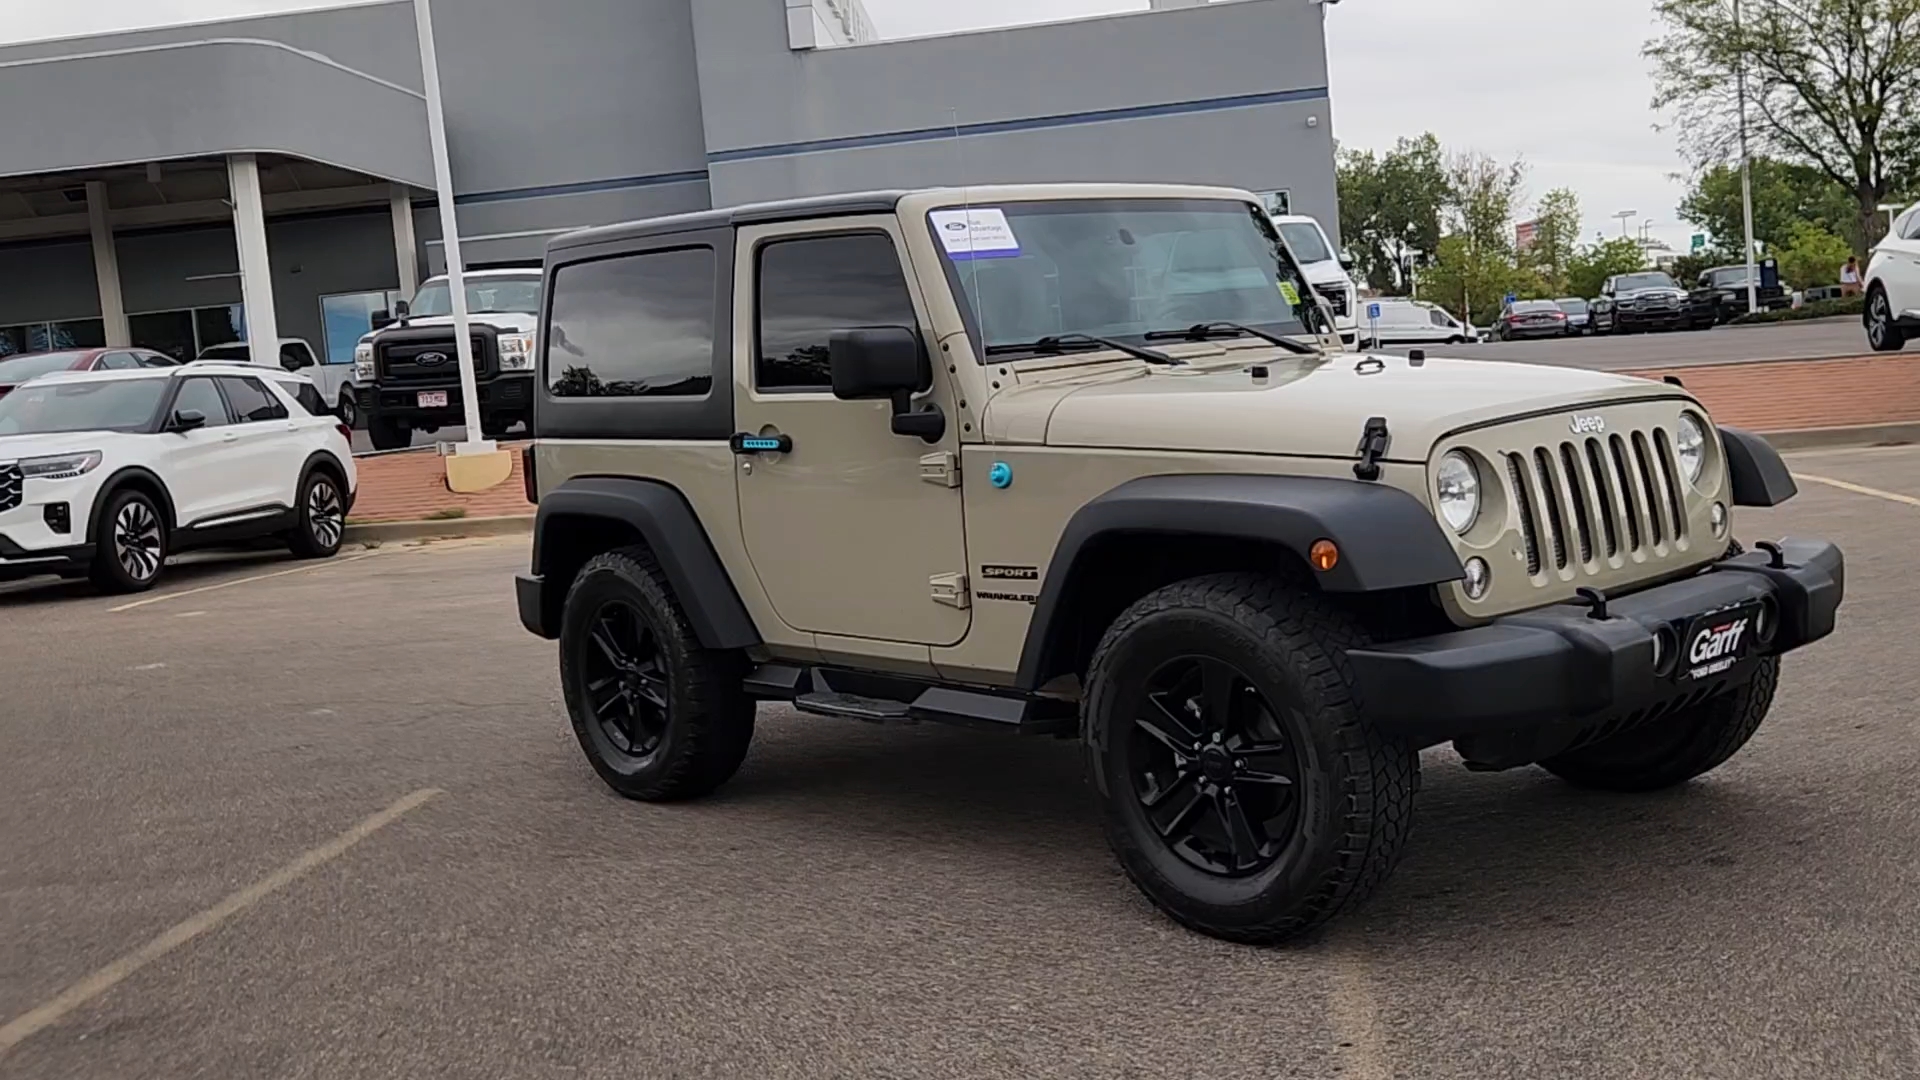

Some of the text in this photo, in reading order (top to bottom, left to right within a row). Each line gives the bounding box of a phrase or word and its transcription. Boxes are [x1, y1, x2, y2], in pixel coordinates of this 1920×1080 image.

[1569, 414, 1605, 433] Jeep
[983, 567, 1038, 578] SPORT
[976, 591, 1036, 602] WRANGLER
[1690, 618, 1748, 664] Garff
